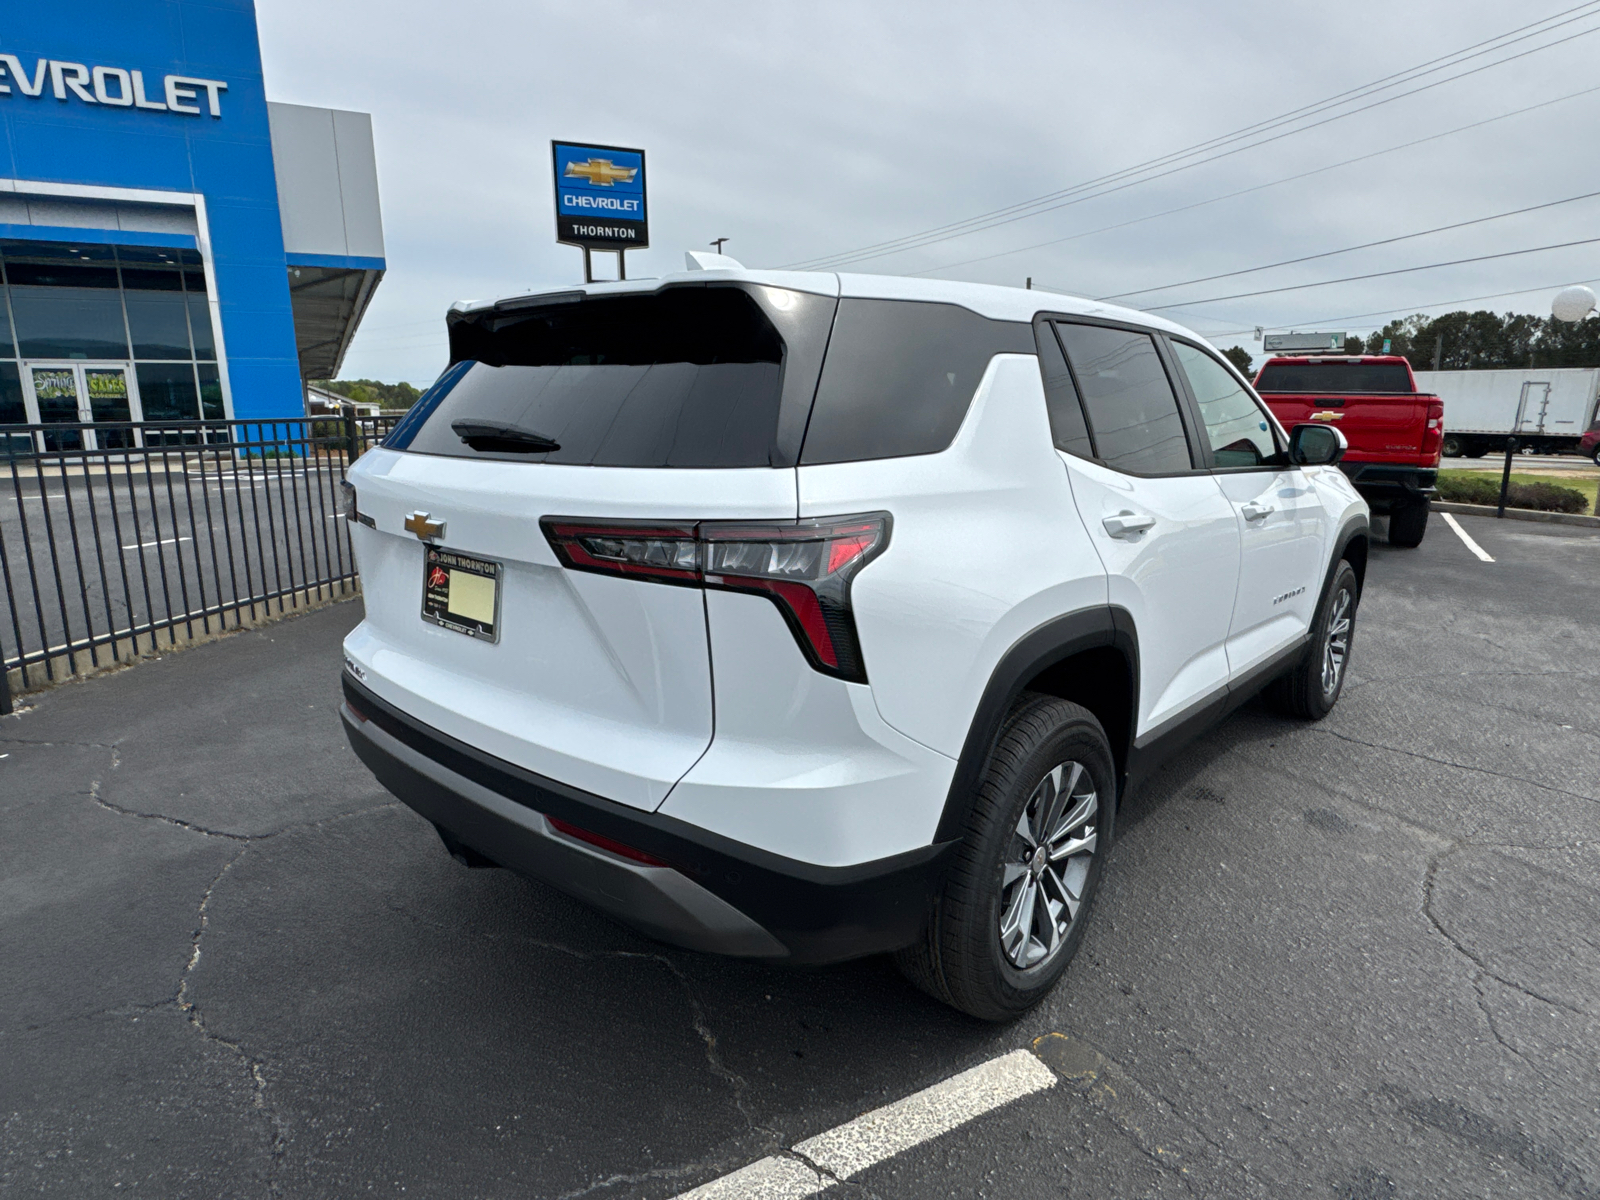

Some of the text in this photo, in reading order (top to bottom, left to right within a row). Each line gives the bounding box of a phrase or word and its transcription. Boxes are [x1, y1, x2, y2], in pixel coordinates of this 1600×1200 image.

[564, 194, 639, 211] CHEVROLET
[572, 224, 636, 238] THORNTON
[90, 379, 126, 392] SALES
[440, 554, 495, 574] JOHN THORNTON
